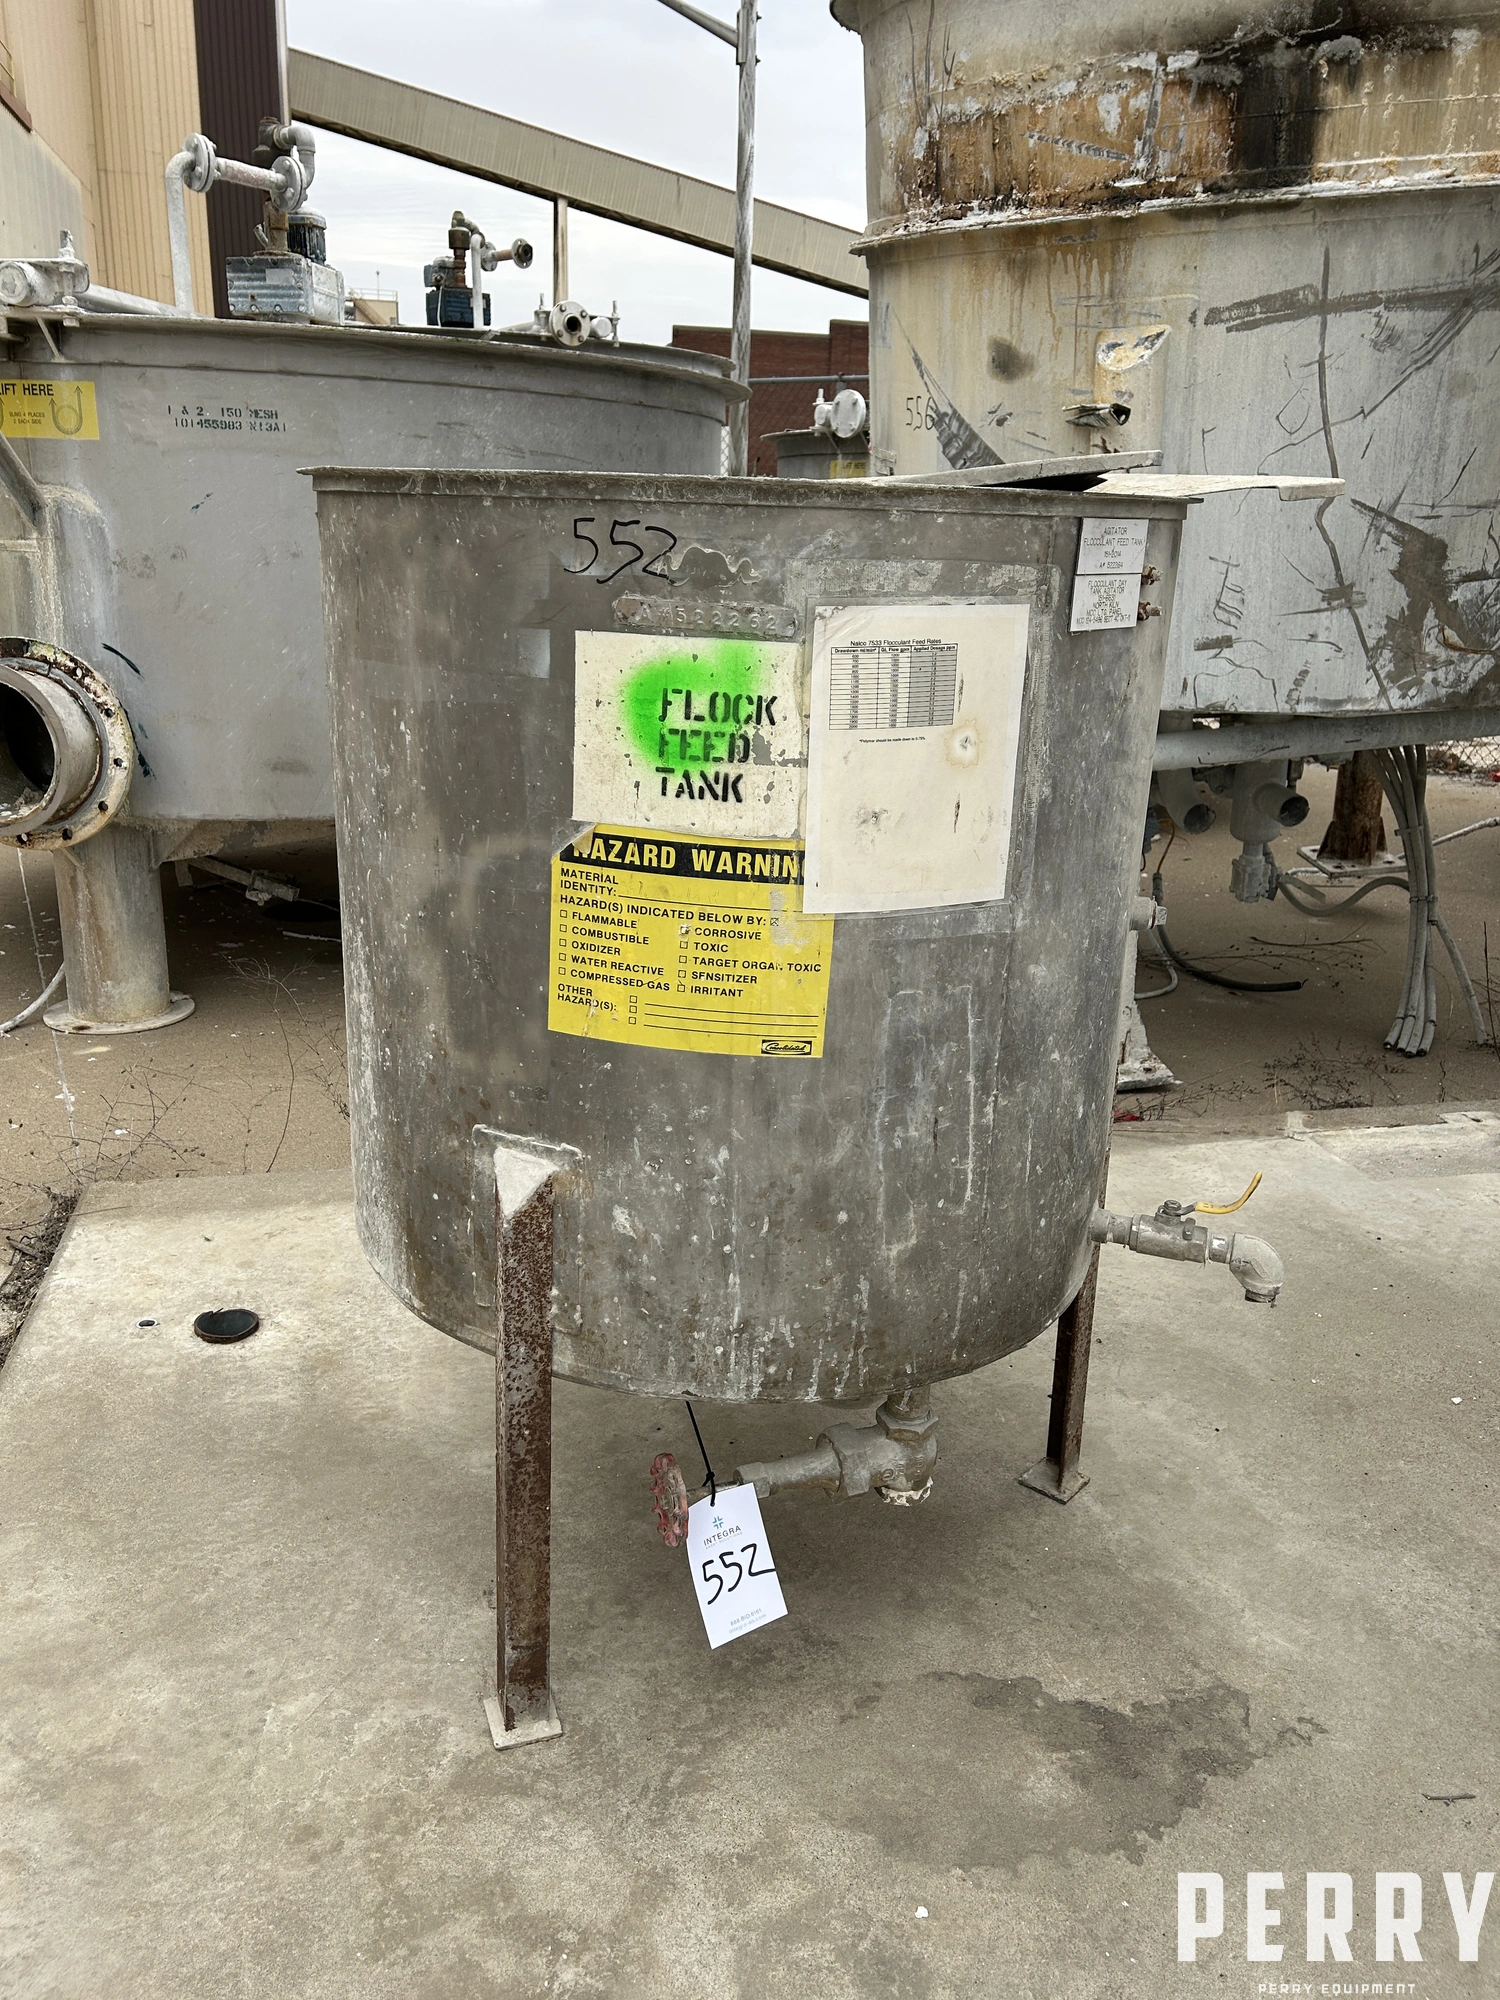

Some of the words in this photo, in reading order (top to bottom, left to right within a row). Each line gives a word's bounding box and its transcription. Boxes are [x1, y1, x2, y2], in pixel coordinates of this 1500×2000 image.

[0, 383, 16, 396] IFT
[23, 384, 54, 396] HERE
[182, 406, 188, 415] &
[221, 407, 242, 417] 150
[249, 409, 278, 419] MESH
[906, 396, 934, 430] 556
[1104, 527, 1128, 535] AGITATOR
[1117, 538, 1129, 546] FEED
[1132, 538, 1143, 546] TANK
[563, 518, 677, 584] 552
[1093, 601, 1108, 609] NORTH
[658, 688, 778, 726] FLOCK
[659, 728, 751, 764] FEED
[655, 766, 744, 803] TANK
[574, 837, 676, 869] AZARD
[692, 849, 805, 878] WARNIN
[560, 868, 619, 885] MATERIAL
[560, 880, 617, 897] IDENTITY:
[559, 895, 624, 915] HAZARD(S)
[627, 904, 694, 921] INDICATED
[698, 912, 743, 925] BELOW
[747, 916, 766, 926] BY:
[571, 912, 638, 929] FLAMMABLE
[571, 926, 650, 945] COMBUSTIBLE
[694, 927, 762, 941] CORROSIVE
[571, 940, 621, 956] OXIDIZER
[693, 941, 729, 953] TOXIC
[571, 954, 608, 969] WATER
[610, 961, 664, 976] REACTIVE
[692, 956, 738, 968] TARGET
[787, 962, 822, 973] TOXIC
[570, 969, 644, 988] COMPRESSED
[646, 981, 670, 991] GAS
[557, 983, 593, 997] OTHER
[690, 985, 744, 997] IRRITANT
[557, 993, 617, 1011] HAZARD(S):
[703, 1525, 742, 1546] INTEGRA
[702, 1543, 776, 1605] 552
